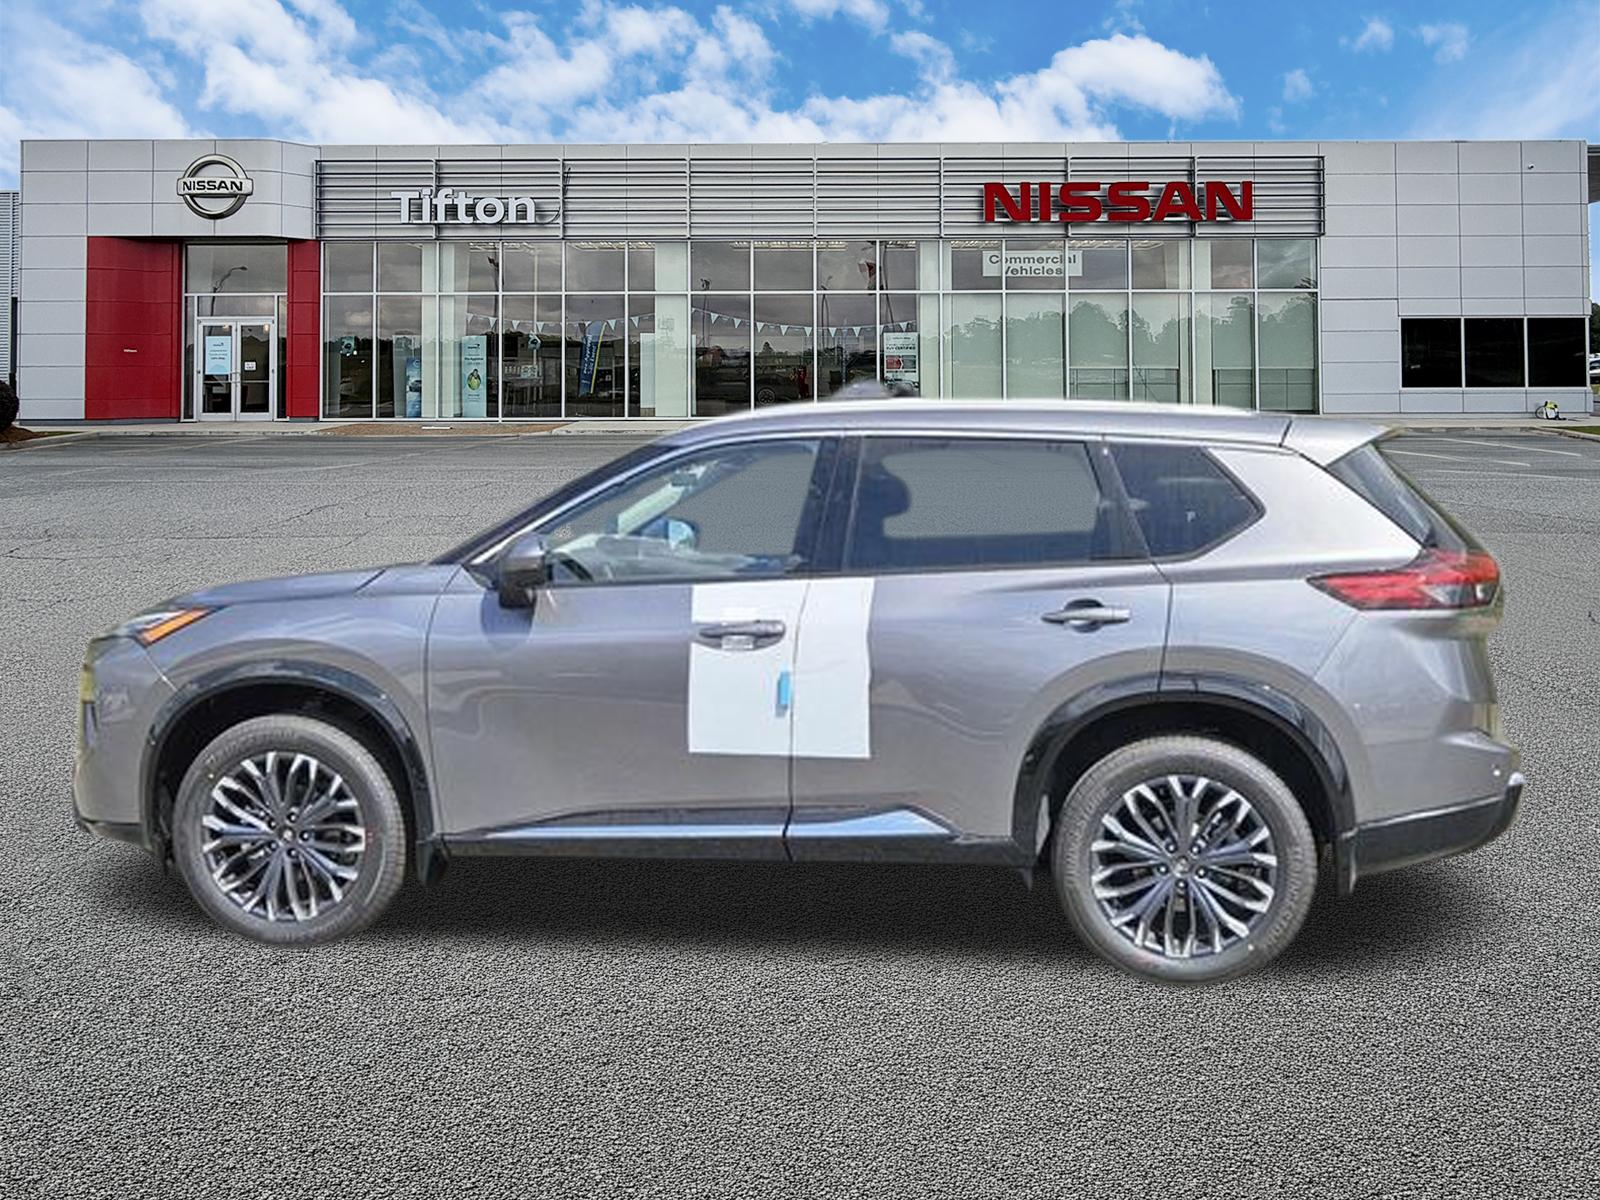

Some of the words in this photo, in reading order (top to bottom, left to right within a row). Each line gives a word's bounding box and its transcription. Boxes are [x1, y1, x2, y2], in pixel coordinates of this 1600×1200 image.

[182, 180, 243, 191] NISSAN
[983, 181, 1253, 222] NISSAN
[391, 188, 536, 224] Tifton
